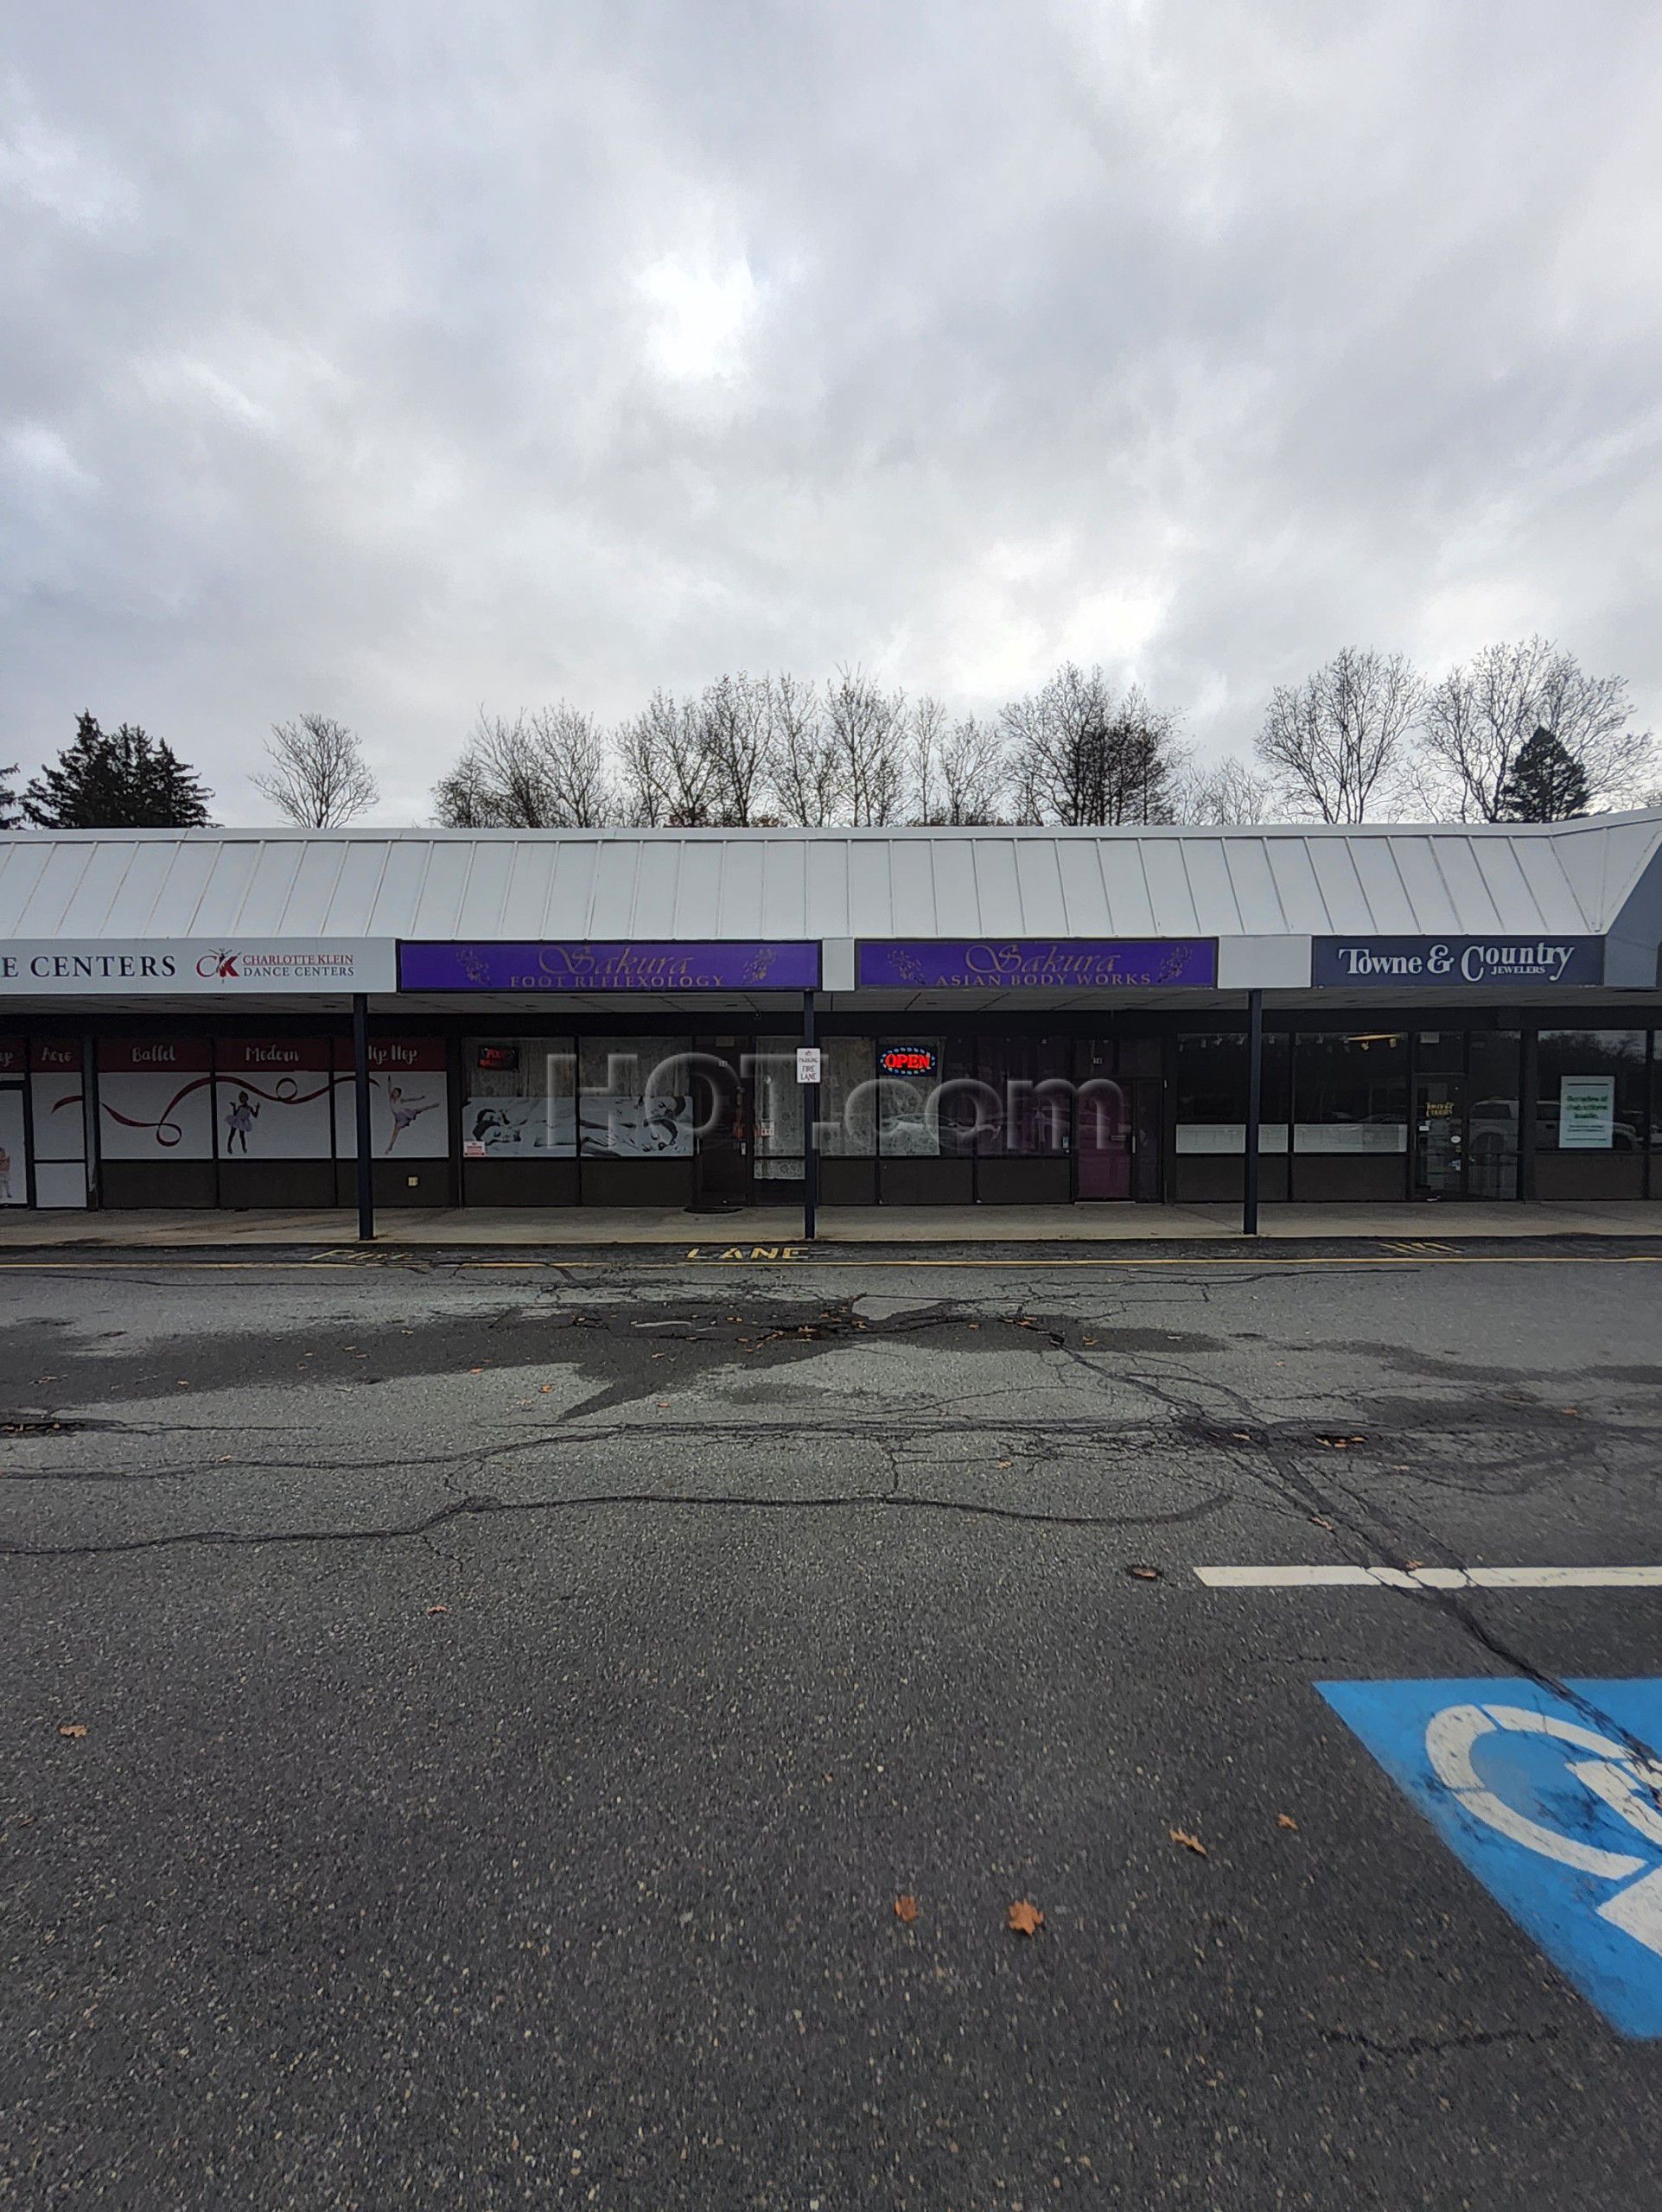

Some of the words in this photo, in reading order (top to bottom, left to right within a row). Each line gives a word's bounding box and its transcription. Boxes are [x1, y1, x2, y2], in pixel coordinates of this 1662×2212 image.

[2, 957, 19, 977] E
[30, 956, 176, 977] CENTERS
[242, 955, 315, 965] CHARLOTTE
[317, 955, 353, 964] KLEIN
[538, 944, 695, 975] Sakura
[965, 944, 1121, 973] Sakura
[1338, 949, 1423, 975] Towne
[1426, 944, 1455, 974] &
[1461, 942, 1575, 982] Country
[243, 967, 290, 976] DANCE
[294, 967, 354, 976] CENTERS
[1491, 966, 1546, 975] JEWELERS
[511, 976, 566, 988] FOOT
[575, 976, 723, 988] REFLEXOLOGY
[936, 976, 1001, 986] ASIAN
[1011, 975, 1067, 985] BODY
[1077, 974, 1151, 985] WORKS
[131, 1046, 176, 1062] Ballet
[245, 1045, 299, 1062] Modern
[885, 1052, 931, 1070] OPEN
[686, 1247, 809, 1259] LANE
